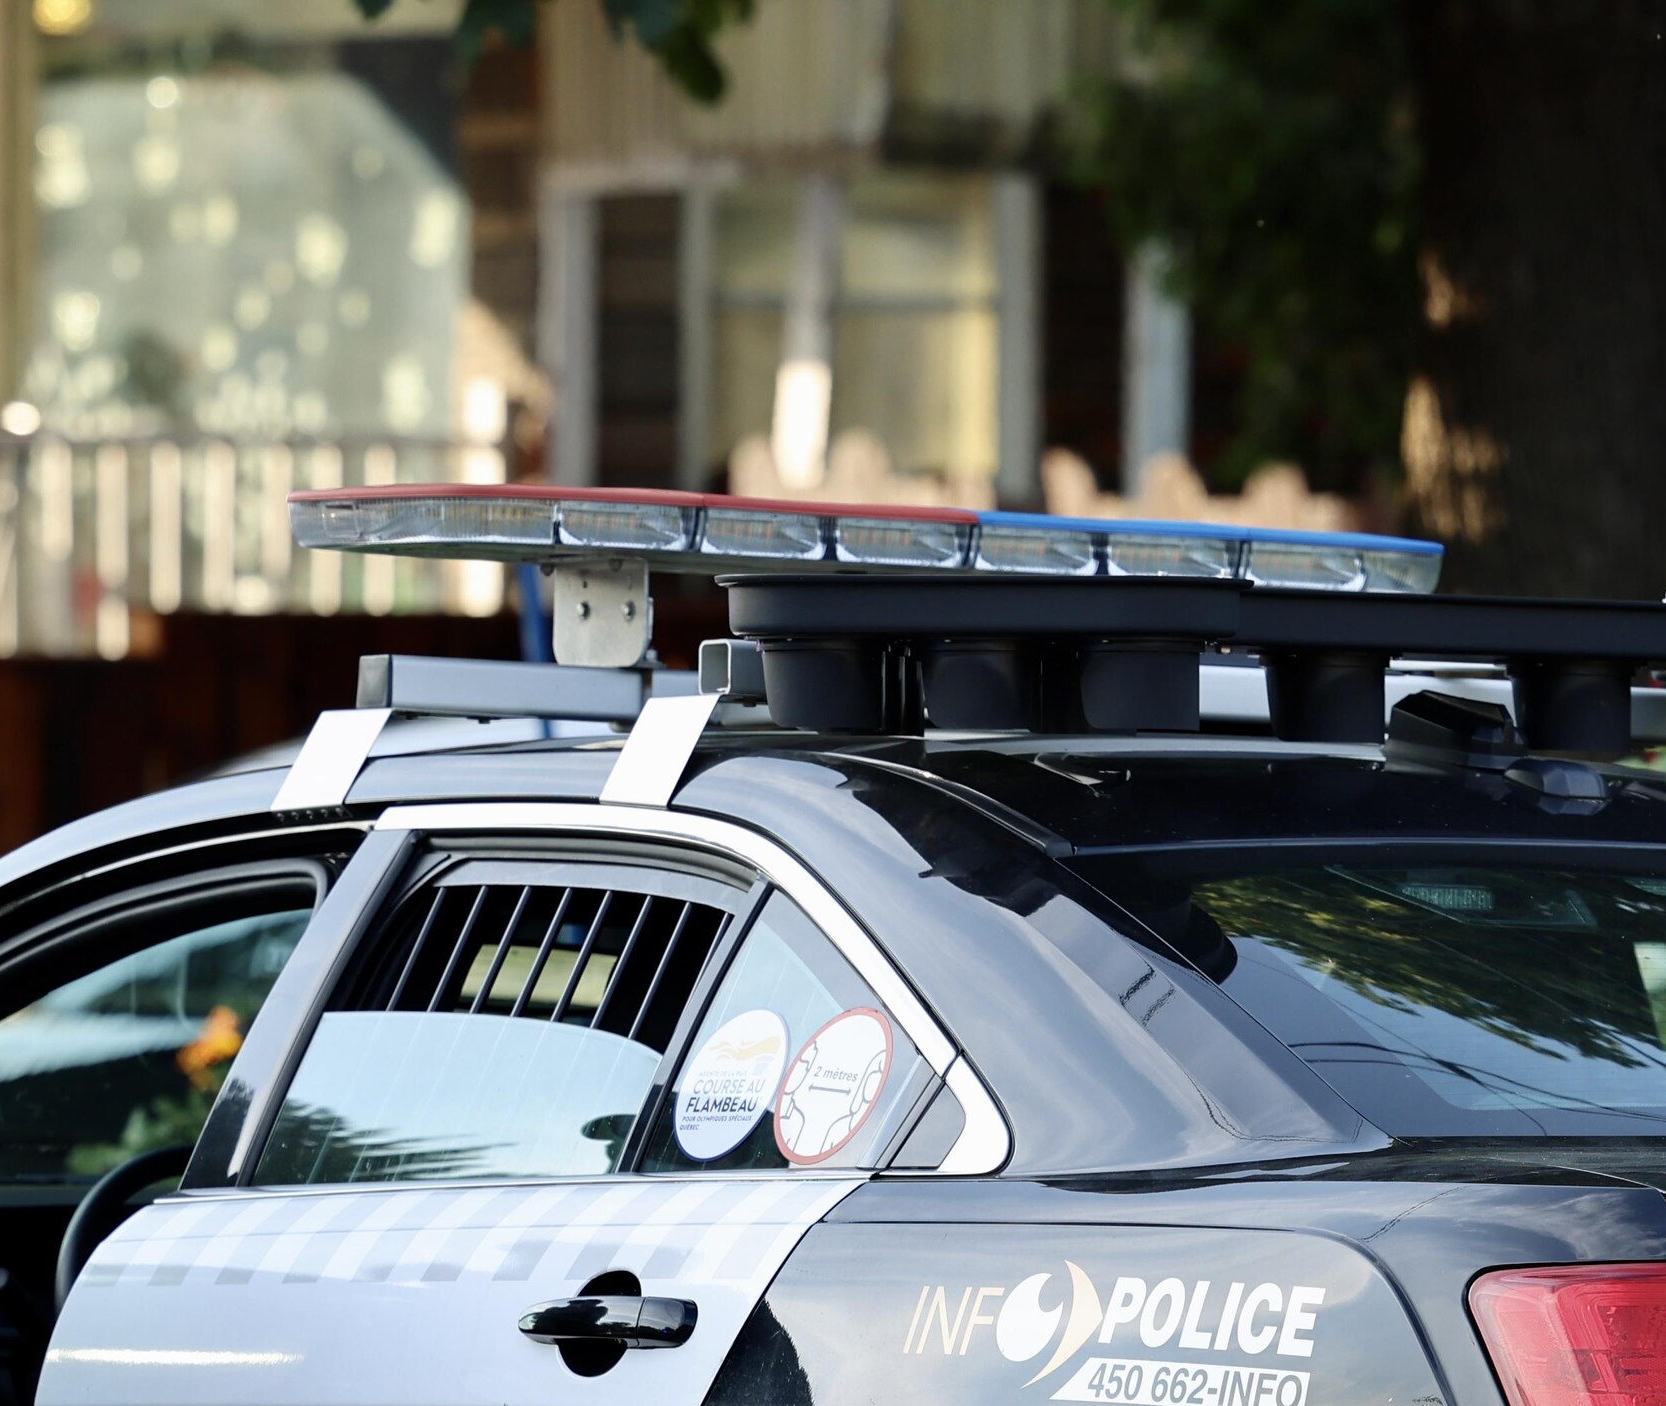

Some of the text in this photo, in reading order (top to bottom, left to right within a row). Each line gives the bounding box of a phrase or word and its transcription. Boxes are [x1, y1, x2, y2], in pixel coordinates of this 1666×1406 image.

[814, 1066, 858, 1082] 2 mètres
[693, 1079, 765, 1094] COURSE AU
[685, 1096, 758, 1113] FLAMBEAU
[696, 1115, 728, 1123] OLYMPIQUES
[1098, 1276, 1326, 1358] POLICE
[1088, 1364, 1139, 1401] 450
